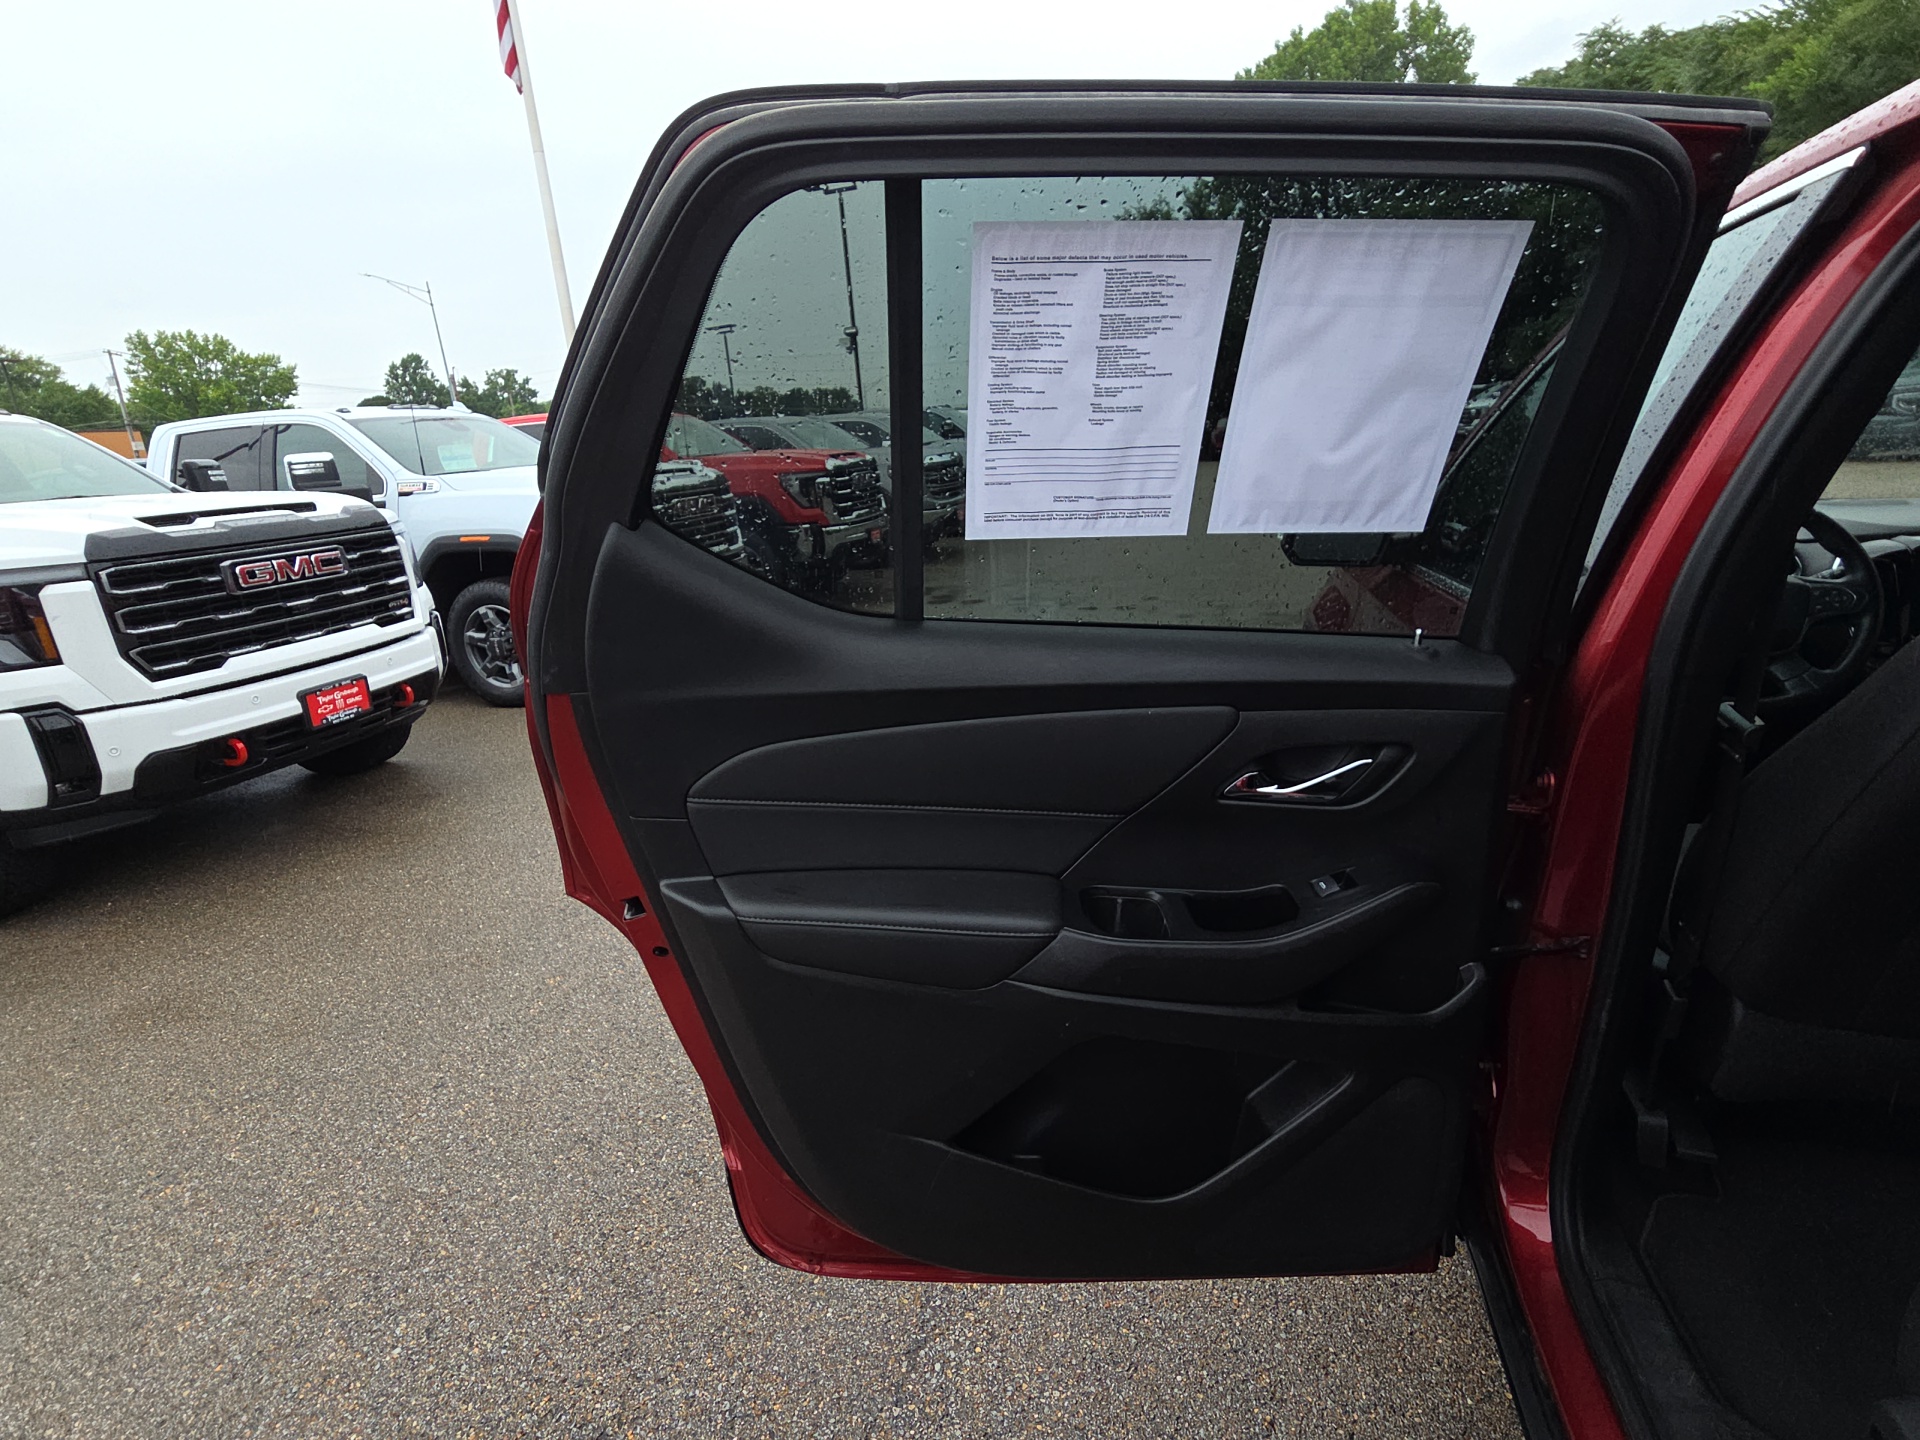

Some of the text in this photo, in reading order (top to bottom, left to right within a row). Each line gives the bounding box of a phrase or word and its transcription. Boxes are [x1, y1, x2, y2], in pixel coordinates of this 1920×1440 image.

[236, 550, 345, 587] GMC
[317, 694, 333, 705] Taylor
[346, 694, 363, 704] GMC
